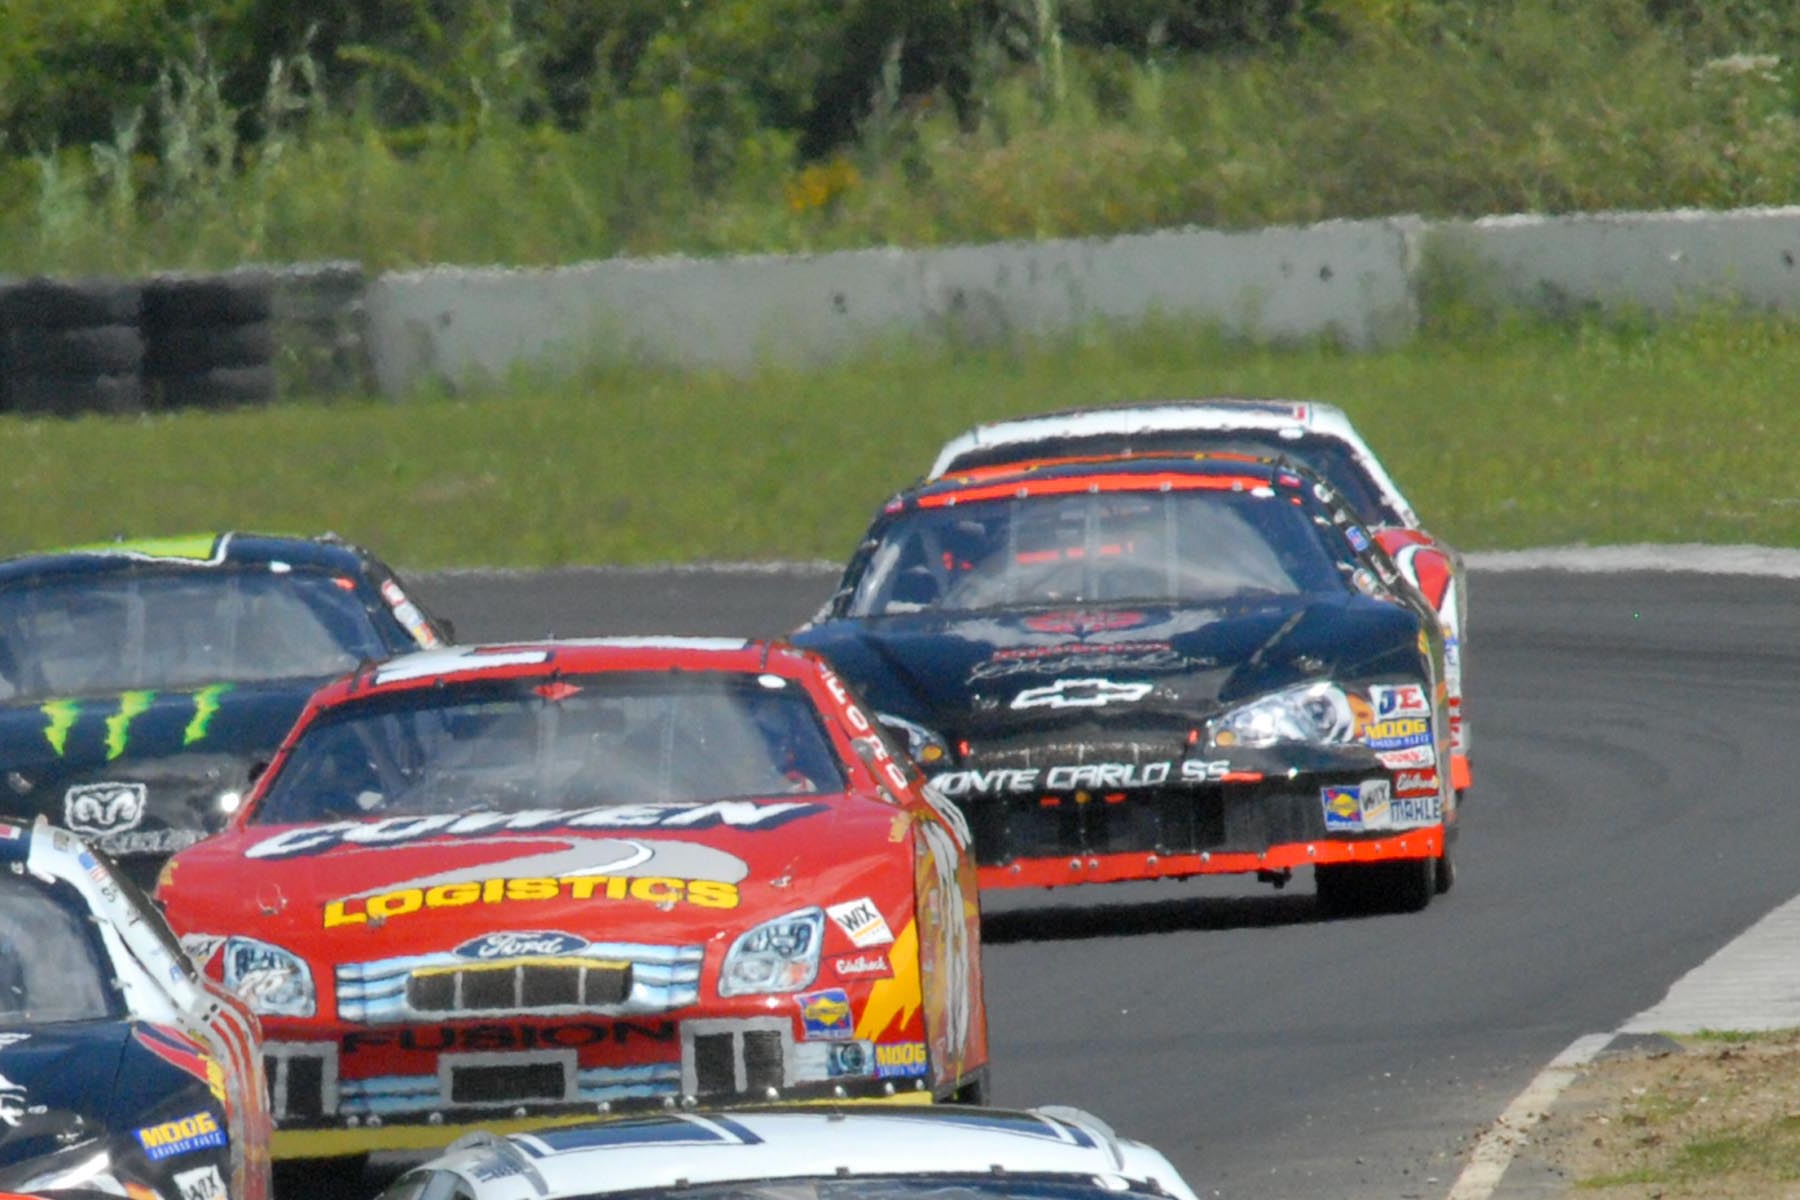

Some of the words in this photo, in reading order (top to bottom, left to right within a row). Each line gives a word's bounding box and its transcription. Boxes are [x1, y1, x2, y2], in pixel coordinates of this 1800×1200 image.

[1379, 688, 1421, 715] JE
[1365, 719, 1427, 740] MOOG
[1046, 761, 1171, 790] CARLO
[1182, 758, 1230, 782] SS
[1390, 799, 1440, 823] MAHLE
[323, 874, 740, 928] LOGISTICS
[837, 903, 878, 932] WIX
[478, 932, 565, 958] Ford
[343, 1019, 677, 1055] FUSION
[877, 1043, 927, 1066] MOOG
[140, 1112, 218, 1147] MOOG
